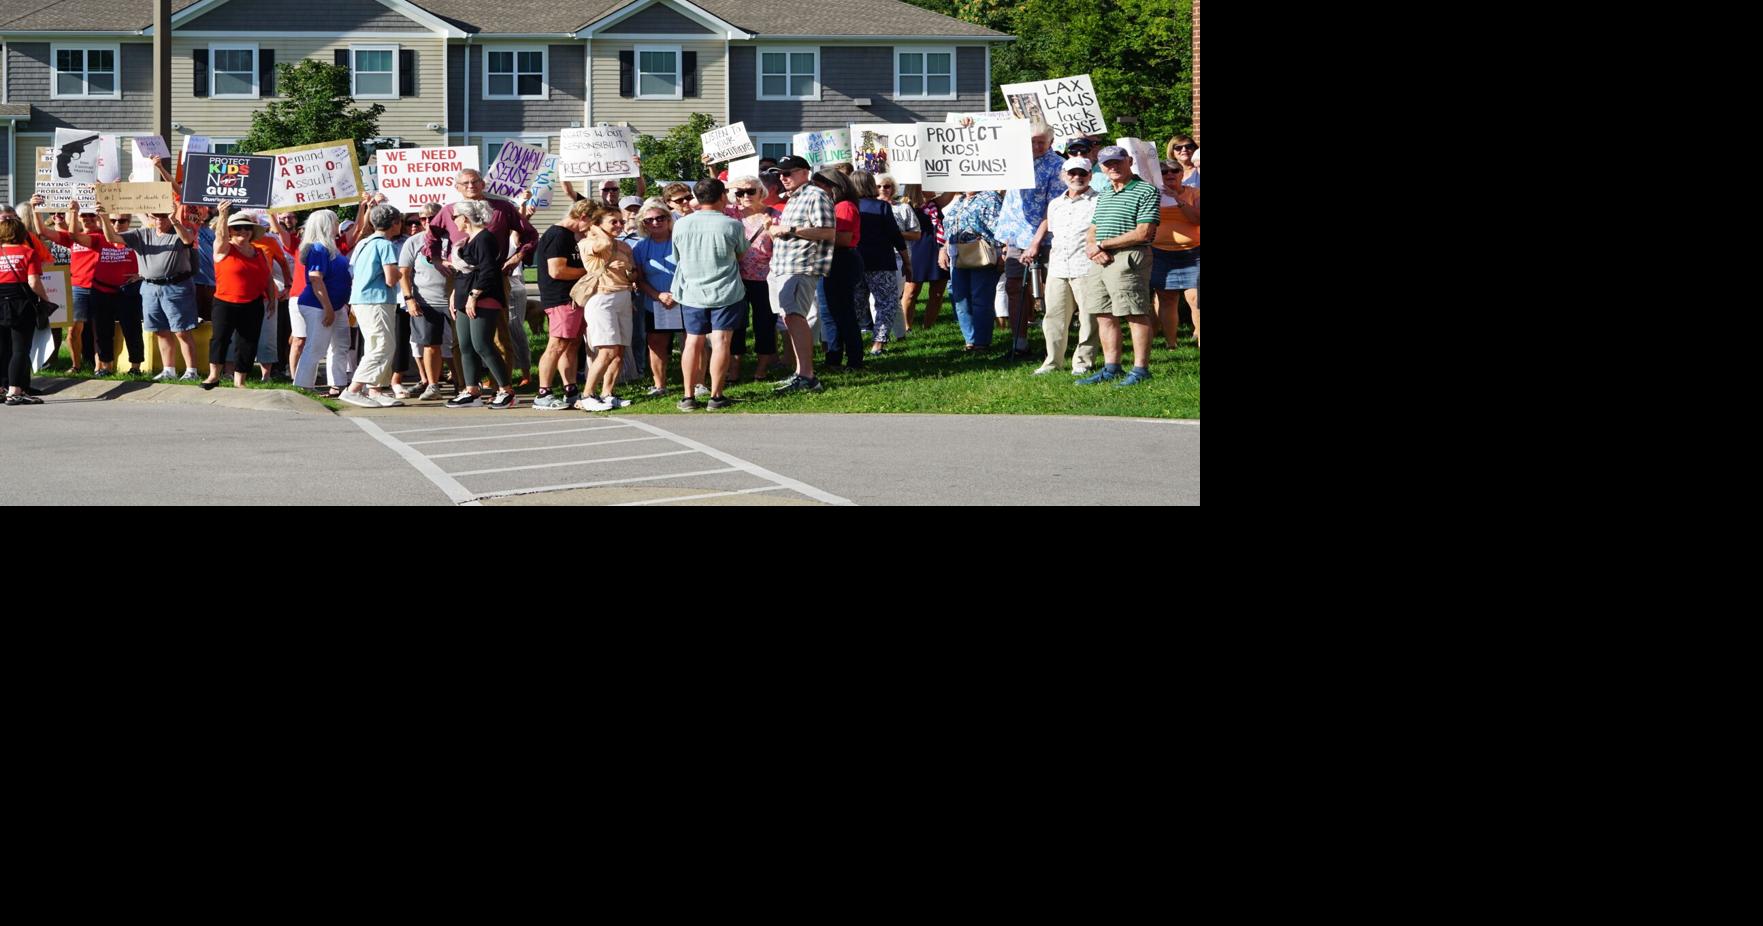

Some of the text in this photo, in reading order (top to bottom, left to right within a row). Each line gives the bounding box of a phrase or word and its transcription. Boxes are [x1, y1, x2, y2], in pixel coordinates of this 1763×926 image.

[1044, 79, 1084, 95] LAX
[1044, 92, 1094, 110] LAWS
[1057, 107, 1095, 122] lack
[927, 126, 1003, 142] PROTECT
[1052, 118, 1101, 137] SENSE
[894, 134, 917, 147] GU
[386, 149, 456, 161] WE NEED
[501, 141, 545, 171] COMMON
[824, 148, 853, 162] LIVES
[942, 143, 979, 156] KIDS!
[209, 157, 250, 166] PROTECT
[277, 149, 324, 166] Demand
[209, 164, 250, 175] KIDS
[281, 160, 343, 177] A Ban On
[382, 164, 398, 174] TO
[407, 162, 463, 173] REFORM
[563, 160, 630, 174] RECKLESS
[925, 158, 1007, 173] NOT GUNS!
[285, 172, 334, 190] Assault
[382, 177, 411, 188] GUN
[416, 176, 454, 187] LAWS
[490, 161, 533, 188] SENSE
[206, 186, 247, 197] GUNS
[296, 186, 336, 203] Rifles!
[409, 194, 446, 205] NOW!
